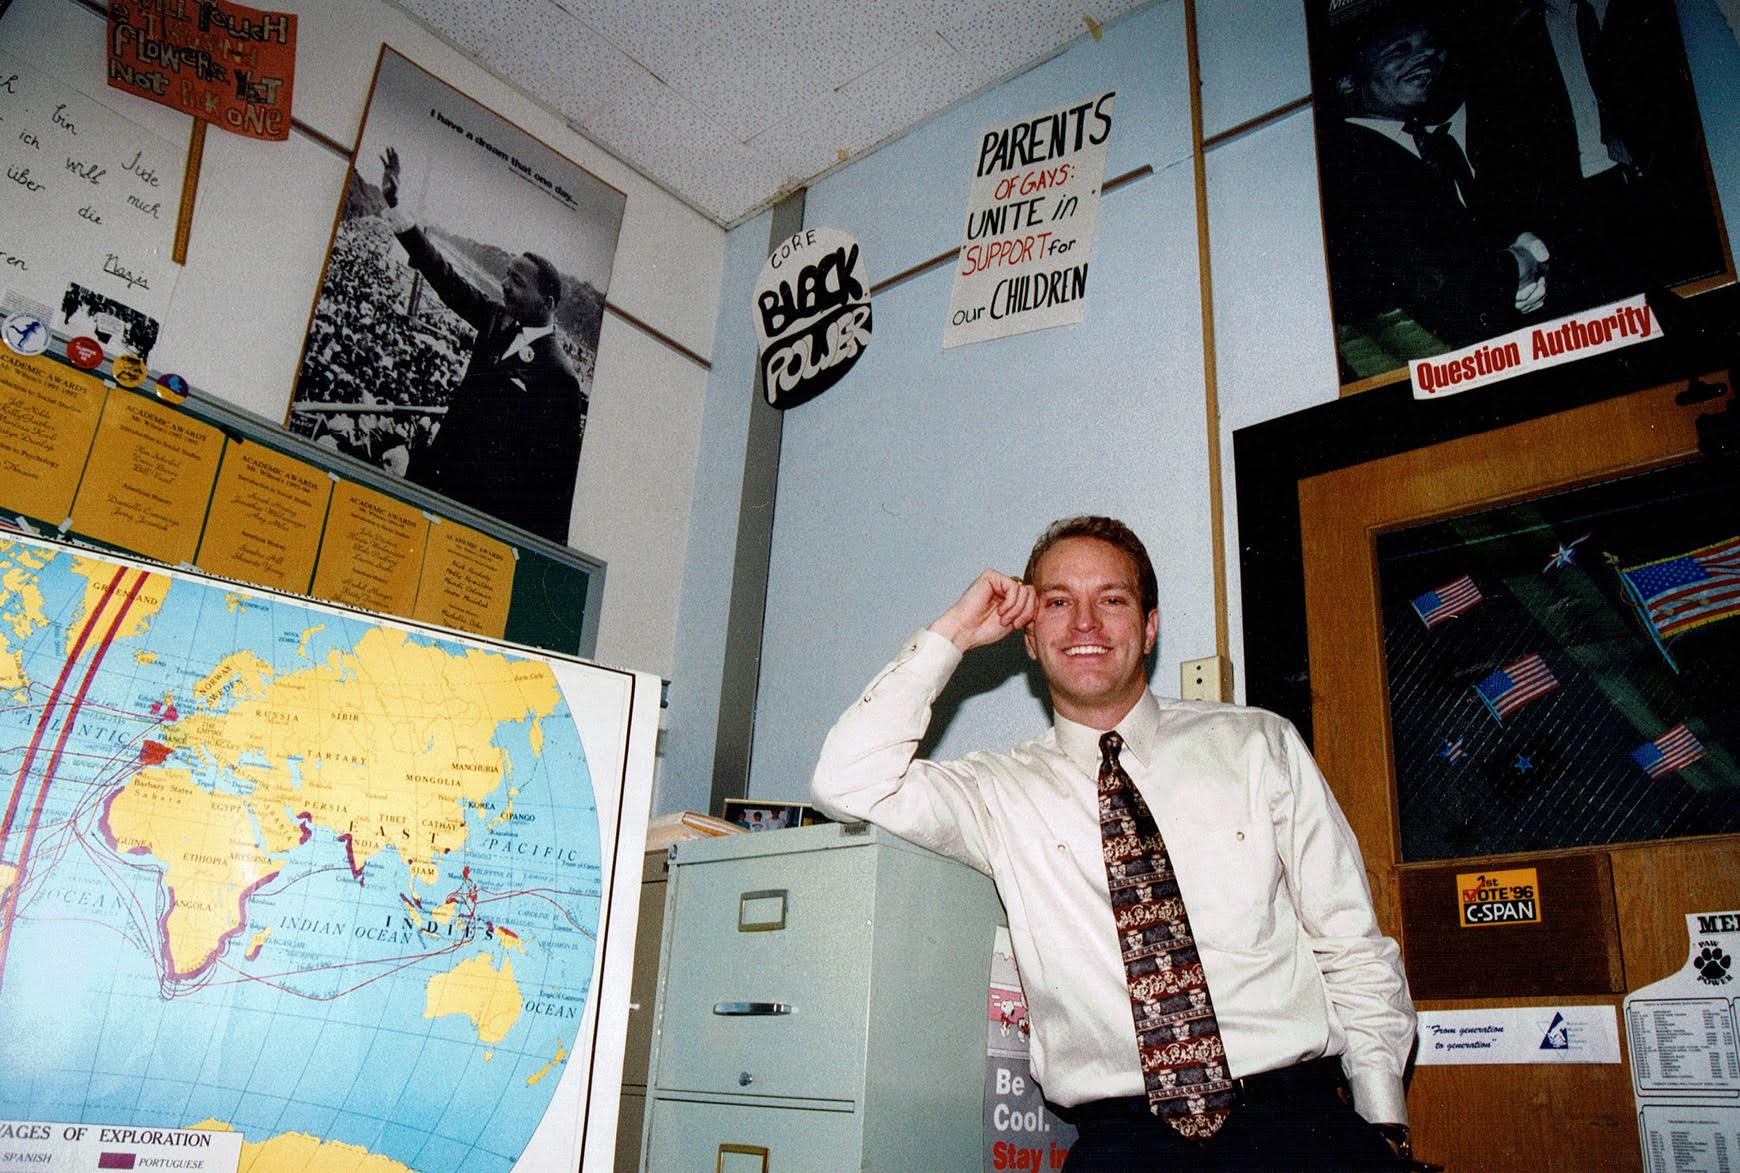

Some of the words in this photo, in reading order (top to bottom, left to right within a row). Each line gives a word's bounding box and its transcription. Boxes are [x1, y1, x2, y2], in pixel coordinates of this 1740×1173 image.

[51, 104, 77, 135] bin
[19, 129, 40, 149] ich
[977, 92, 1116, 177] PARENTS
[430, 108, 436, 118] I
[436, 112, 464, 134] have
[465, 131, 475, 141] a
[475, 136, 509, 162] dream
[511, 156, 533, 176] that
[534, 172, 553, 189] one
[994, 177, 1017, 200] OF
[1019, 164, 1075, 196] GAYS:
[78, 206, 102, 225] die
[967, 196, 1046, 240] UNITE
[1051, 194, 1078, 220] in
[771, 229, 816, 269] CORE
[962, 232, 1052, 276] SUPPORT
[1048, 238, 1076, 256] for
[758, 243, 864, 338] BLACK
[952, 306, 986, 326] our
[990, 263, 1089, 320] CHILDREN
[767, 305, 872, 404] POWER
[1416, 341, 1522, 395] Question
[1532, 303, 1653, 361] Authority
[46, 374, 87, 394] AWARDS
[126, 405, 170, 426] ACADEMIC
[171, 422, 207, 441] AWARDS
[243, 455, 284, 474] ACADEMIC
[285, 473, 318, 490] AWARDS
[348, 497, 386, 515] ACADEMIC
[387, 512, 417, 528] AWARDS
[199, 664, 232, 695] NORWAY
[207, 679, 243, 705] SWEDEN
[256, 710, 299, 721] RUSSIA
[331, 712, 359, 721] SIBIR
[307, 750, 367, 765] TARTARY
[452, 763, 499, 773] MANCHURIA
[134, 779, 164, 791] Barbary
[170, 784, 193, 795] States
[406, 774, 461, 787] MONGOLIA
[211, 802, 241, 813] EGYPT
[304, 801, 348, 813] PERSIA
[468, 801, 495, 810] KOREA
[380, 815, 406, 824] TIBET
[422, 820, 456, 831] CATHAY
[501, 812, 535, 822] CIPANGO
[117, 836, 153, 849] GUINEA
[353, 838, 380, 849] NDIA
[488, 838, 577, 862] PACIFIC
[183, 853, 228, 867] ETHIOPIA
[411, 867, 435, 876] SIAM
[174, 900, 213, 913] ANGOLA
[1466, 901, 1534, 922] C-SPAN
[280, 916, 345, 935] INDIAN
[355, 926, 414, 945] OCEAN
[1698, 940, 1719, 948] PAW
[1697, 974, 1734, 986] POWER
[525, 1000, 577, 1019] OCEAN
[1459, 1025, 1504, 1038] generation
[1435, 1041, 1445, 1049] to
[996, 1068, 1024, 1096] Be
[993, 1103, 1050, 1132] Cool.
[63, 1126, 88, 1141] OF
[99, 1128, 212, 1148] EXPLORATION
[2, 1153, 53, 1164] SPANISH
[138, 1158, 204, 1170] PORTUGUESE
[993, 1141, 1043, 1173] Stay
